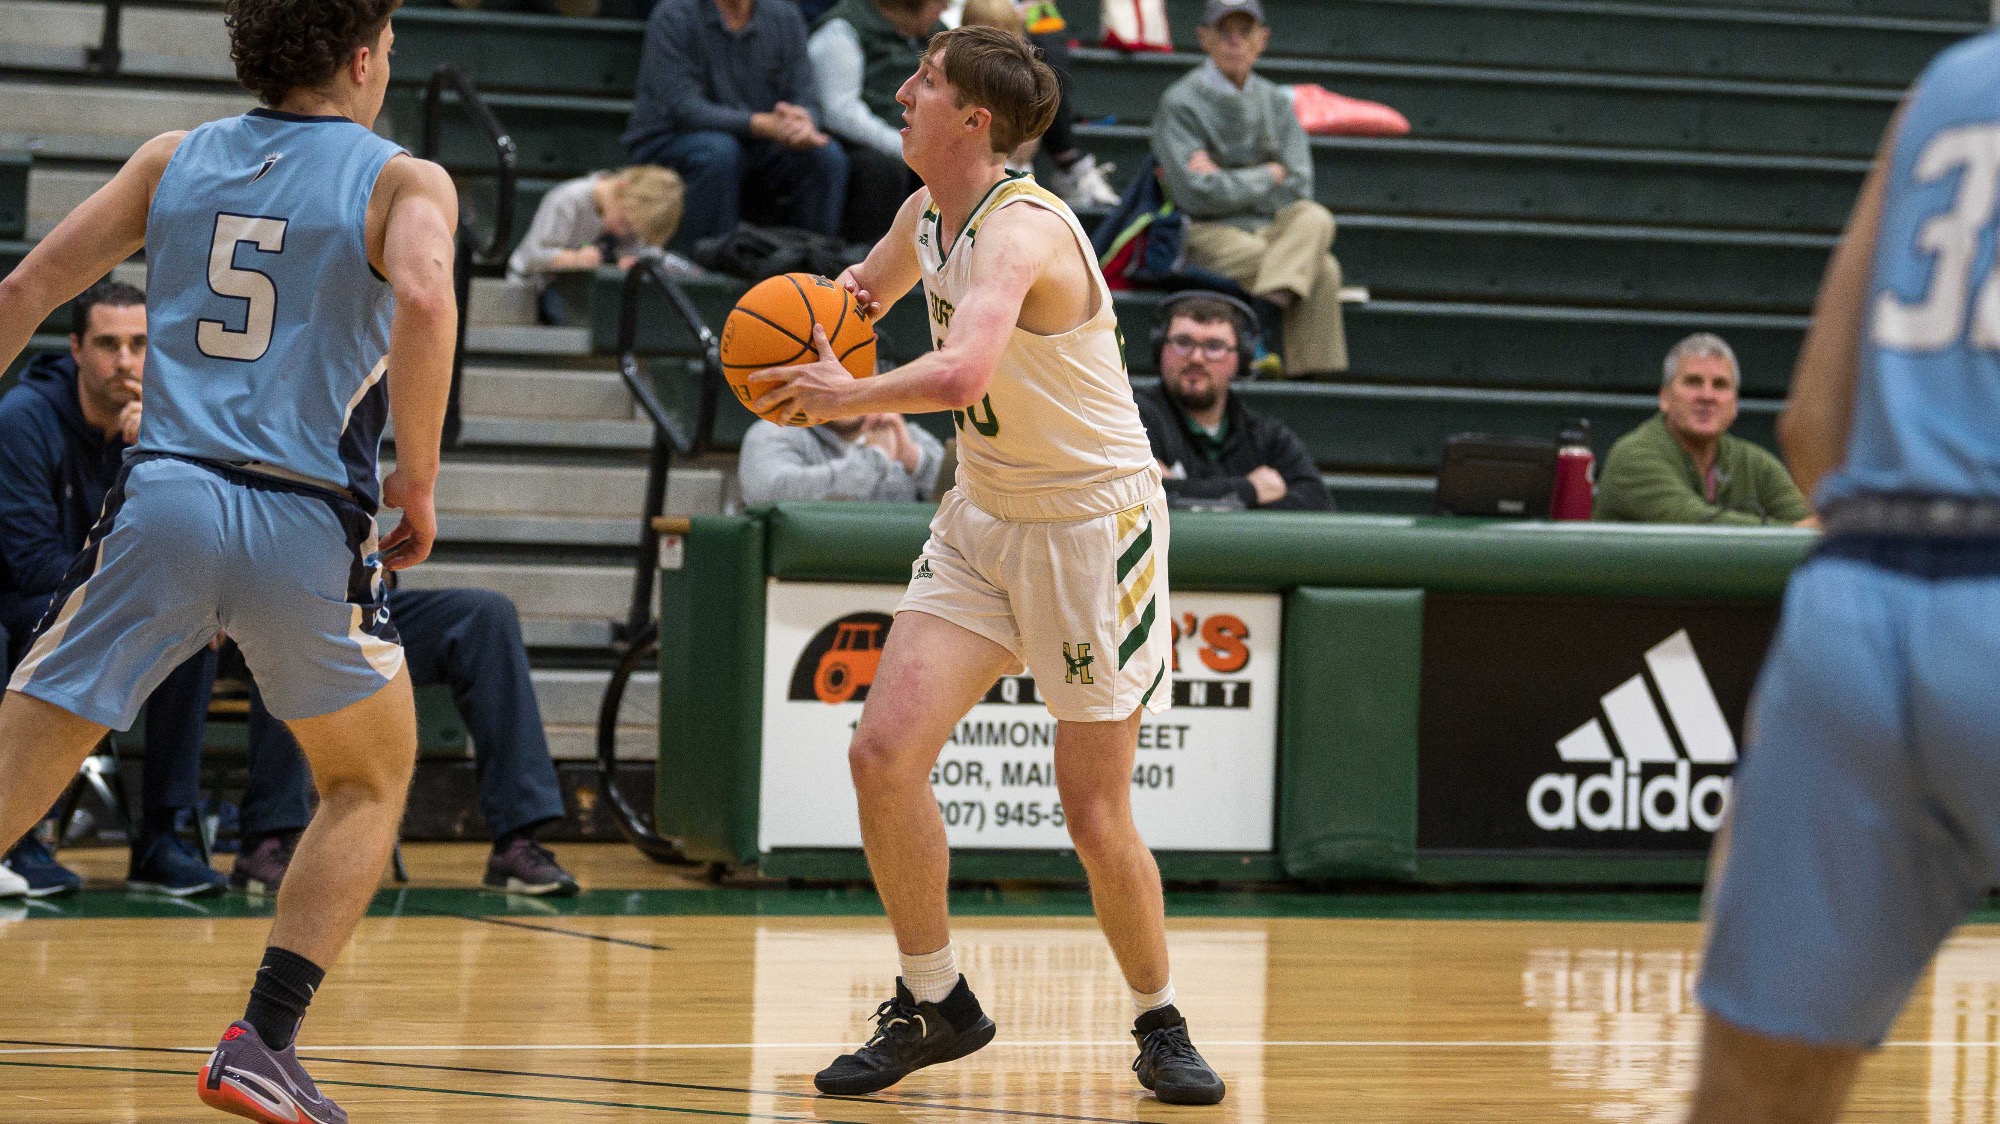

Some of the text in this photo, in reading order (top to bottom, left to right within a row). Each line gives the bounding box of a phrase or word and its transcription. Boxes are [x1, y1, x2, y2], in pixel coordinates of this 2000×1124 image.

[195, 211, 289, 362] 5
[1138, 724, 1190, 749] EET
[1001, 761, 1058, 788] MAI
[1131, 764, 1175, 789] 401
[1526, 756, 1736, 833] adida
[994, 801, 1066, 828] 945-5
